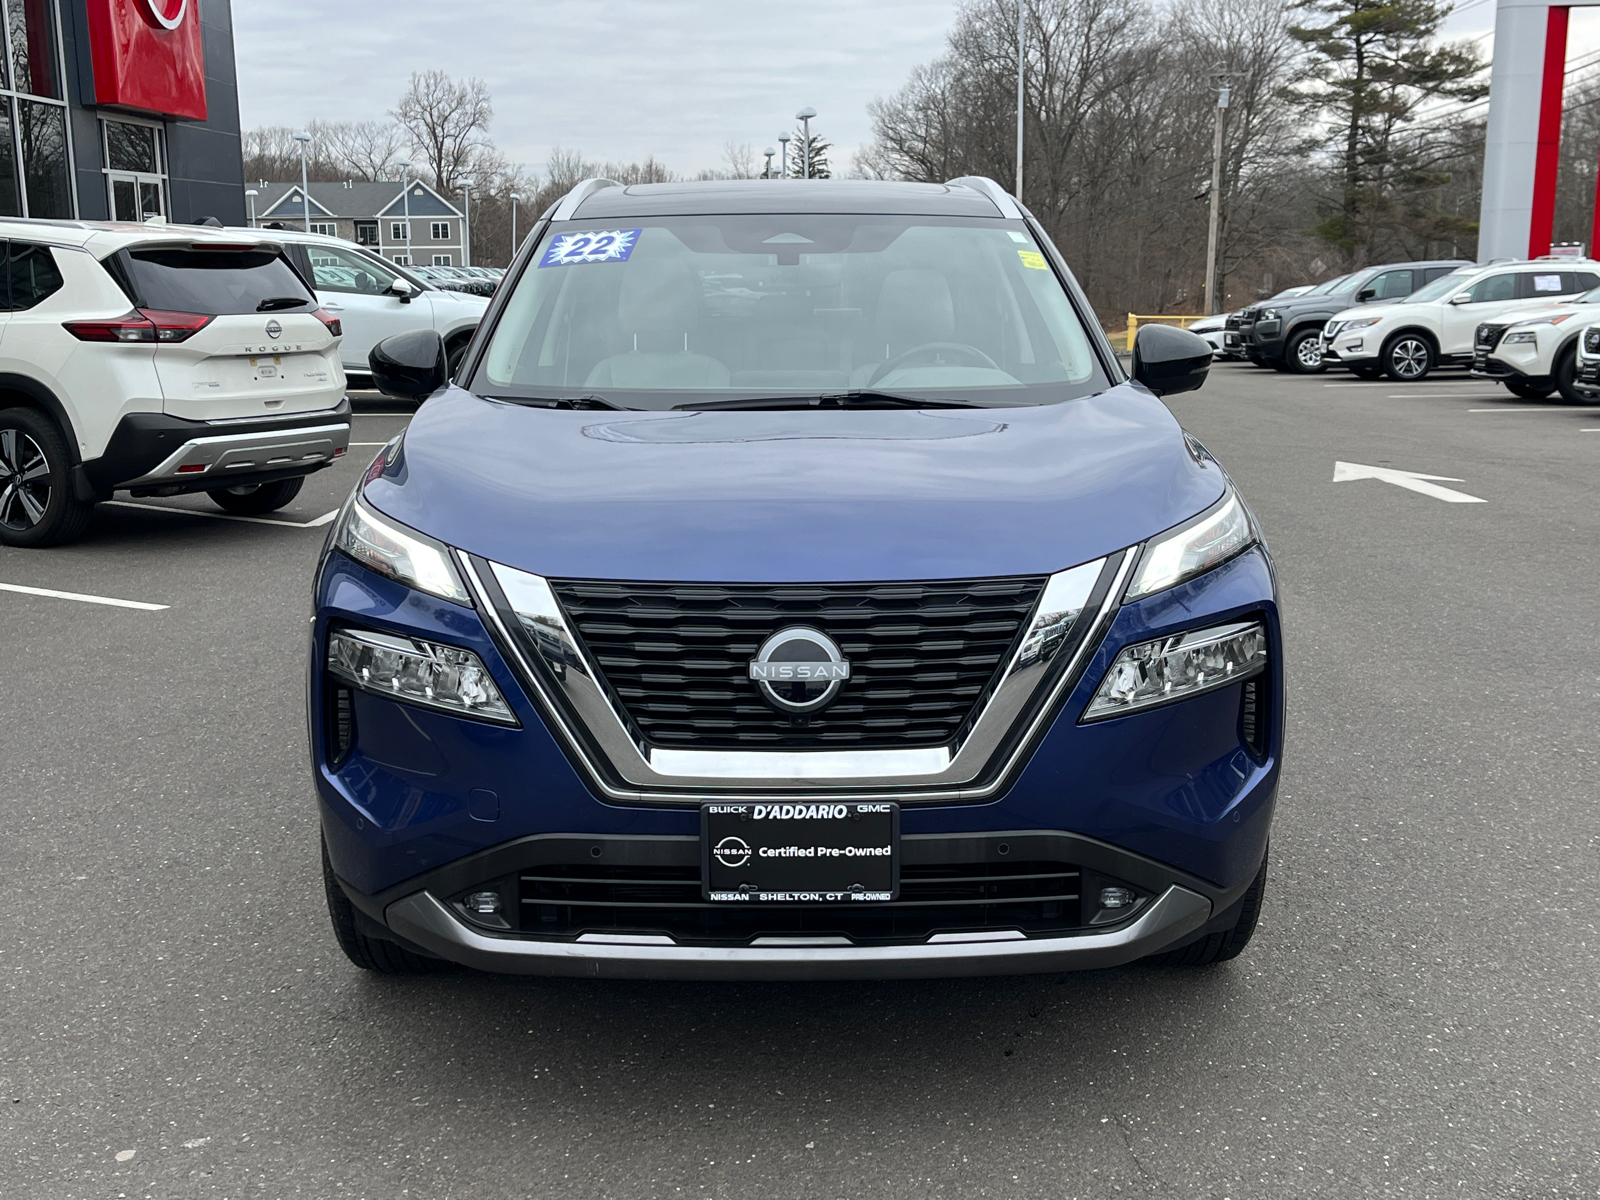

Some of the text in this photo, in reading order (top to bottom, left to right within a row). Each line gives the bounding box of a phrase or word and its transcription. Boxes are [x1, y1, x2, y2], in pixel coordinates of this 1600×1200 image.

[563, 235, 616, 258] 22
[244, 344, 303, 353] ROGUE
[752, 665, 847, 678] NISSAN
[709, 804, 891, 820] BUICK D'ADDARIO GMC
[758, 845, 892, 857] Certified Pre-Owned
[710, 893, 891, 902] NISSAN SHELTON, CT PRE-OWNED
